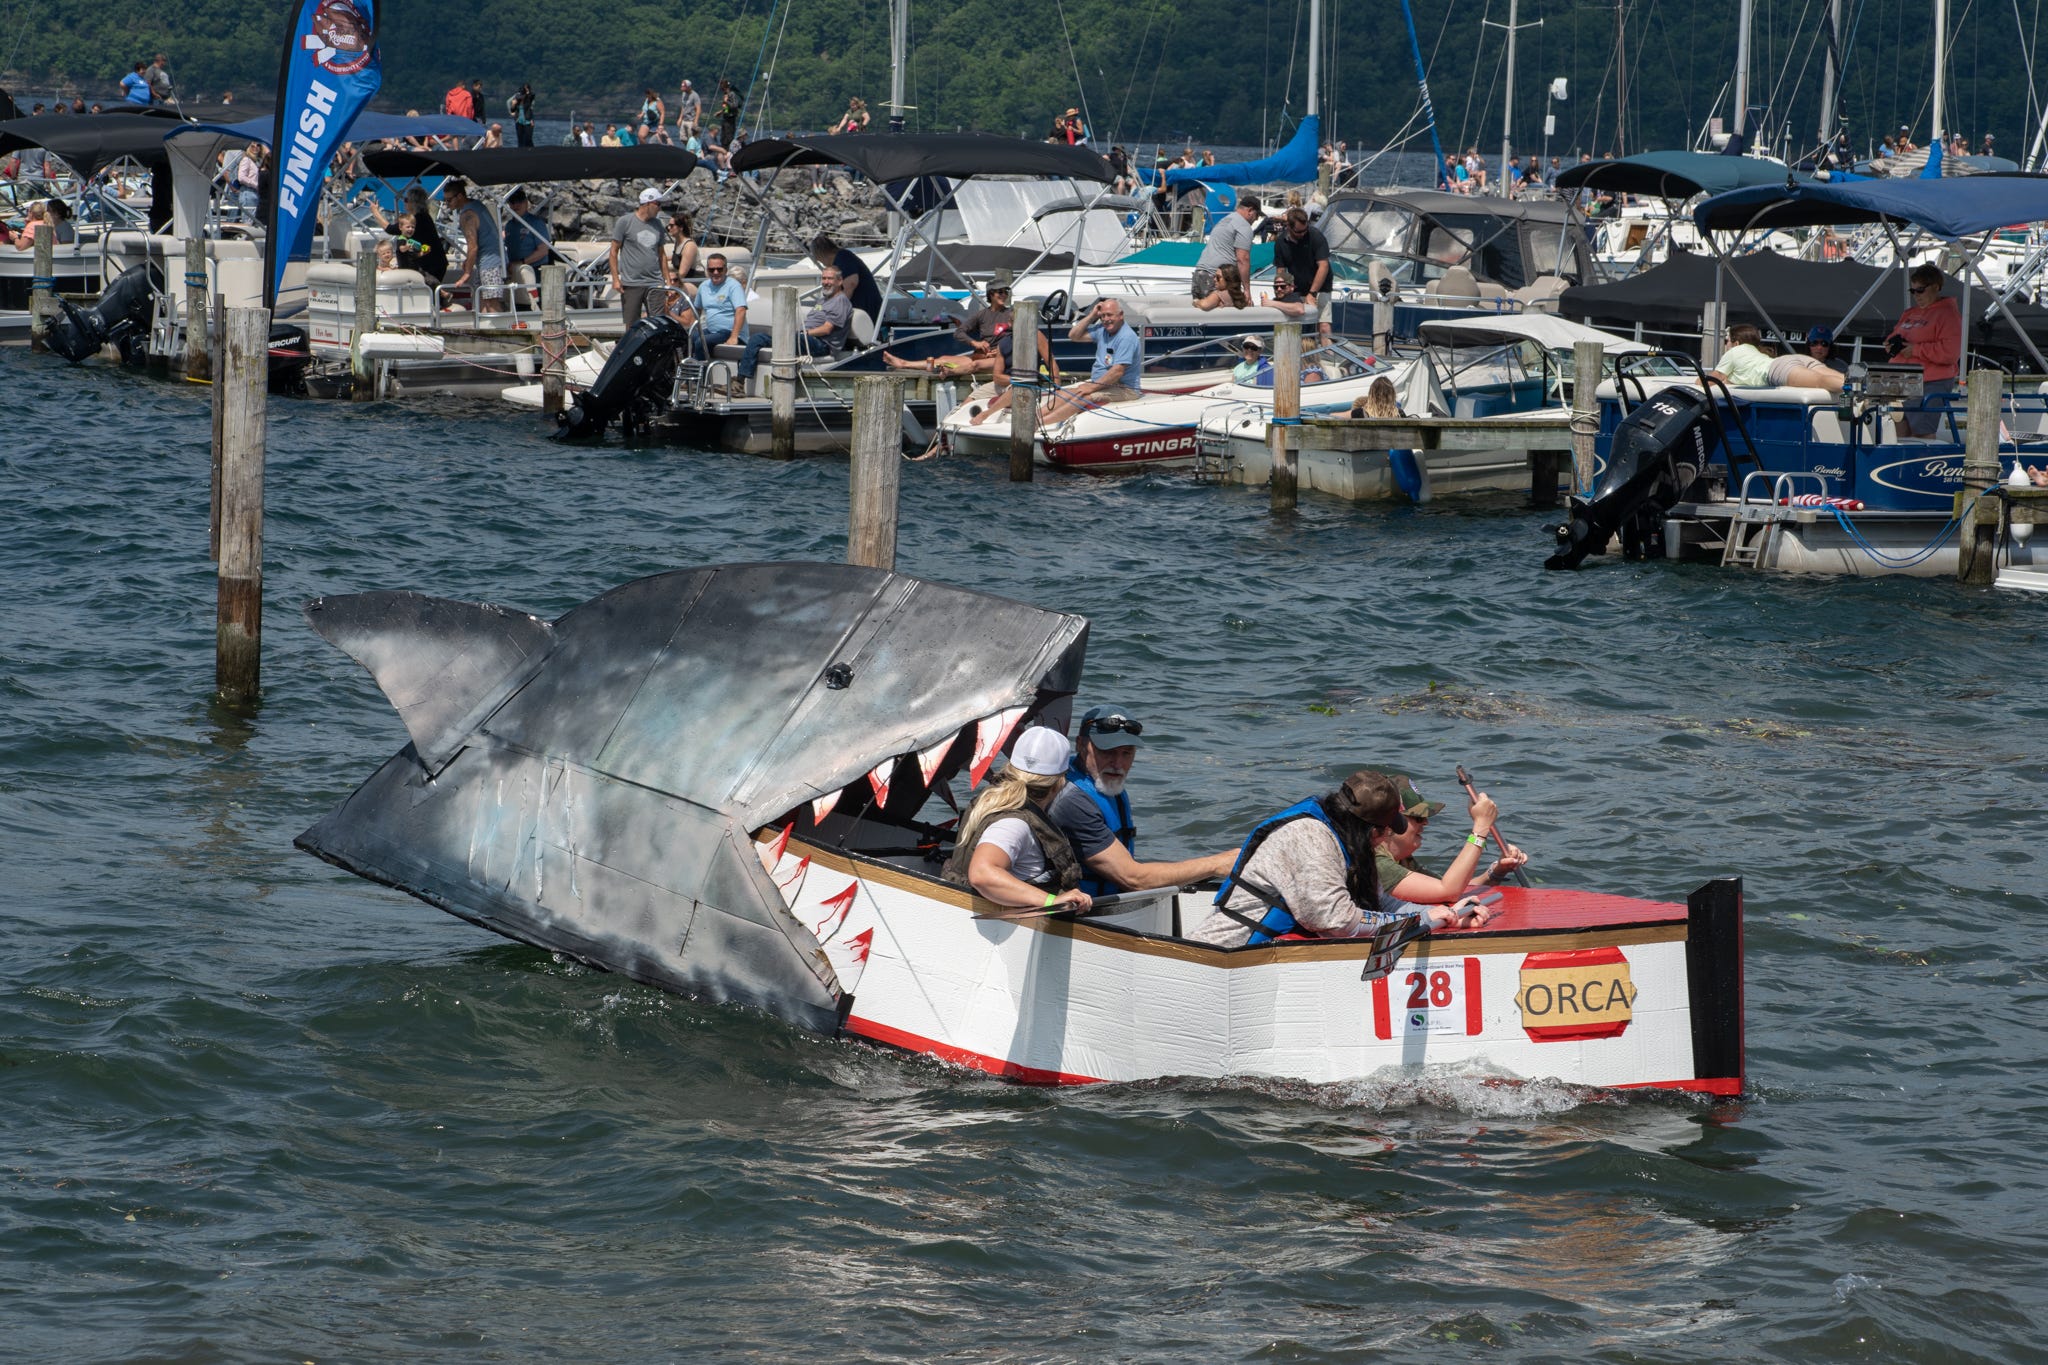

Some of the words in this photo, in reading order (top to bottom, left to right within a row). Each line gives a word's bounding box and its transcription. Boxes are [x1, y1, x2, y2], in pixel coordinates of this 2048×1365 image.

[280, 79, 338, 219] FINISH
[1153, 327, 1165, 337] NY
[1652, 402, 1678, 415] 115
[1121, 437, 1198, 456] STINGR
[1693, 425, 1705, 472] MERCU
[1811, 464, 1847, 477] Bentley
[1405, 970, 1453, 1009] 28
[1525, 978, 1631, 1016] ORCA
